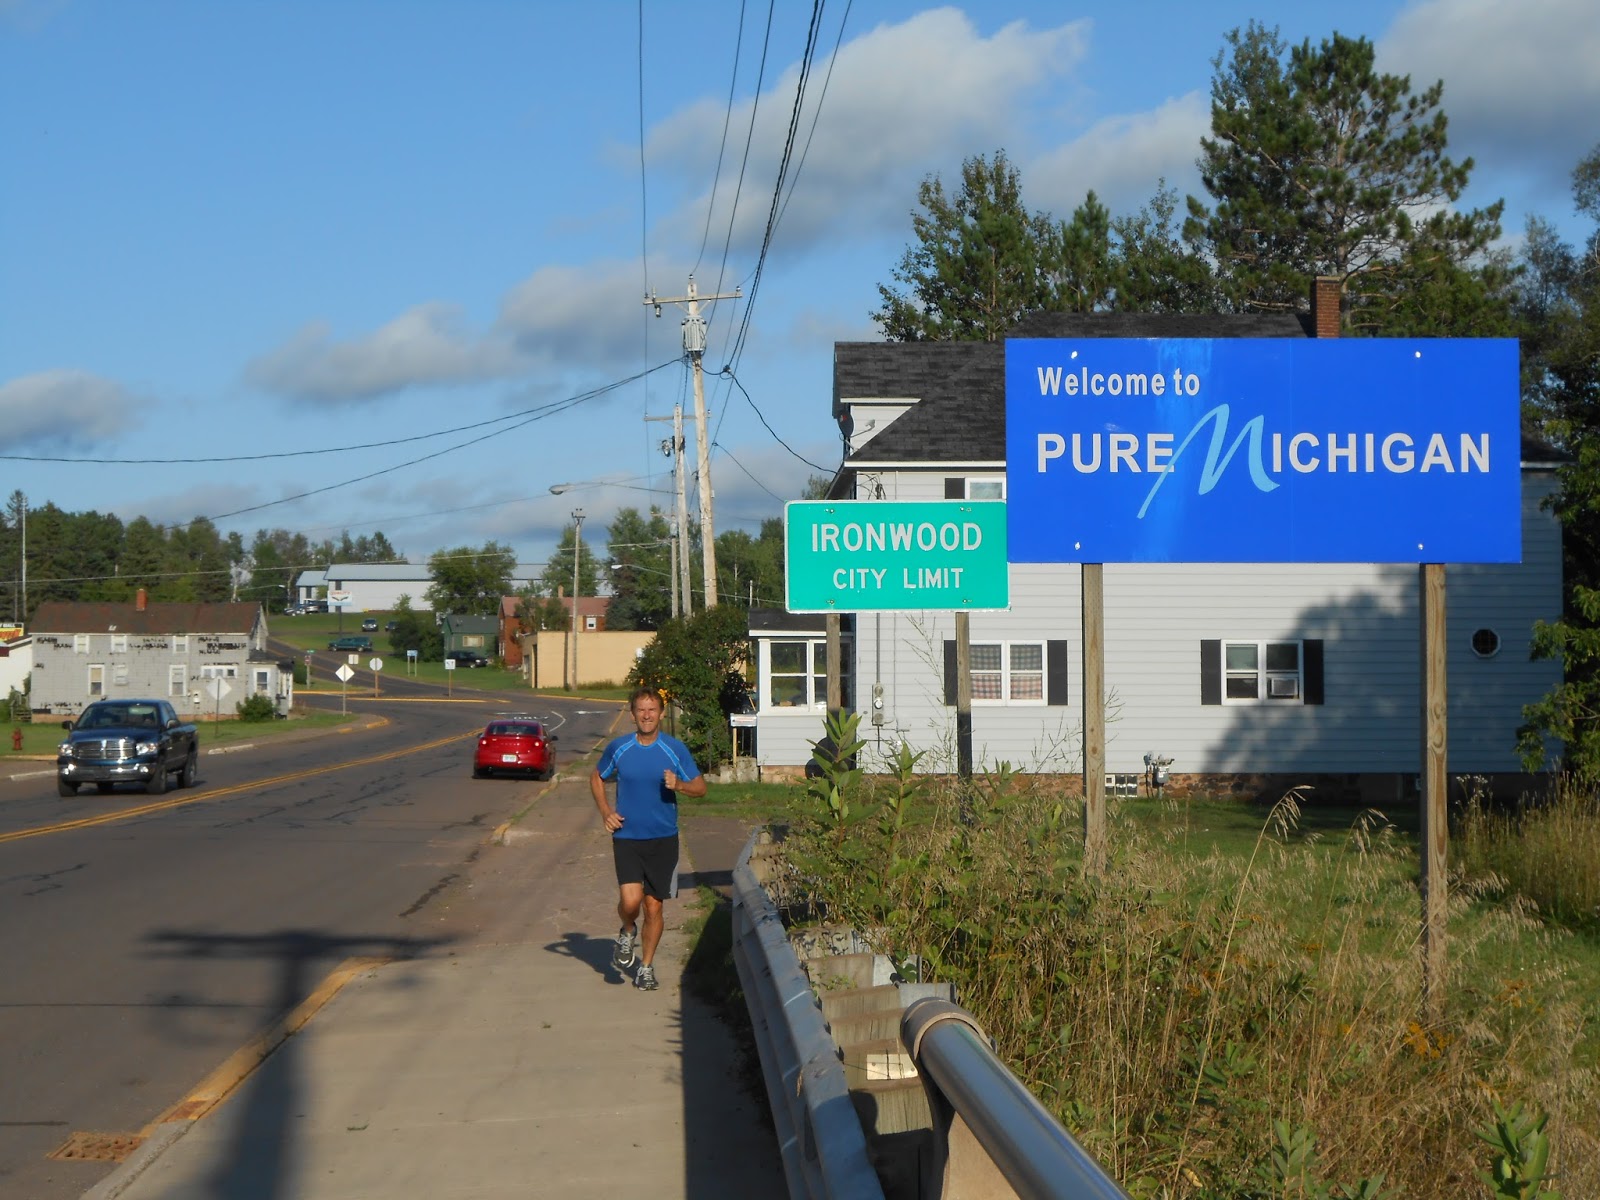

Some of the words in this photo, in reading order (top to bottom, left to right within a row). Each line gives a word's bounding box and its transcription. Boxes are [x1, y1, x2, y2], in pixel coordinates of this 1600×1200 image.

[1037, 366, 1166, 396] Welcome
[1173, 368, 1200, 396] to
[1037, 433, 1175, 474] PURE
[1137, 403, 1490, 519] MICHIGAN
[812, 522, 982, 552] IRONWOOD
[833, 567, 888, 589] CITY
[903, 567, 964, 589] LIMIT
